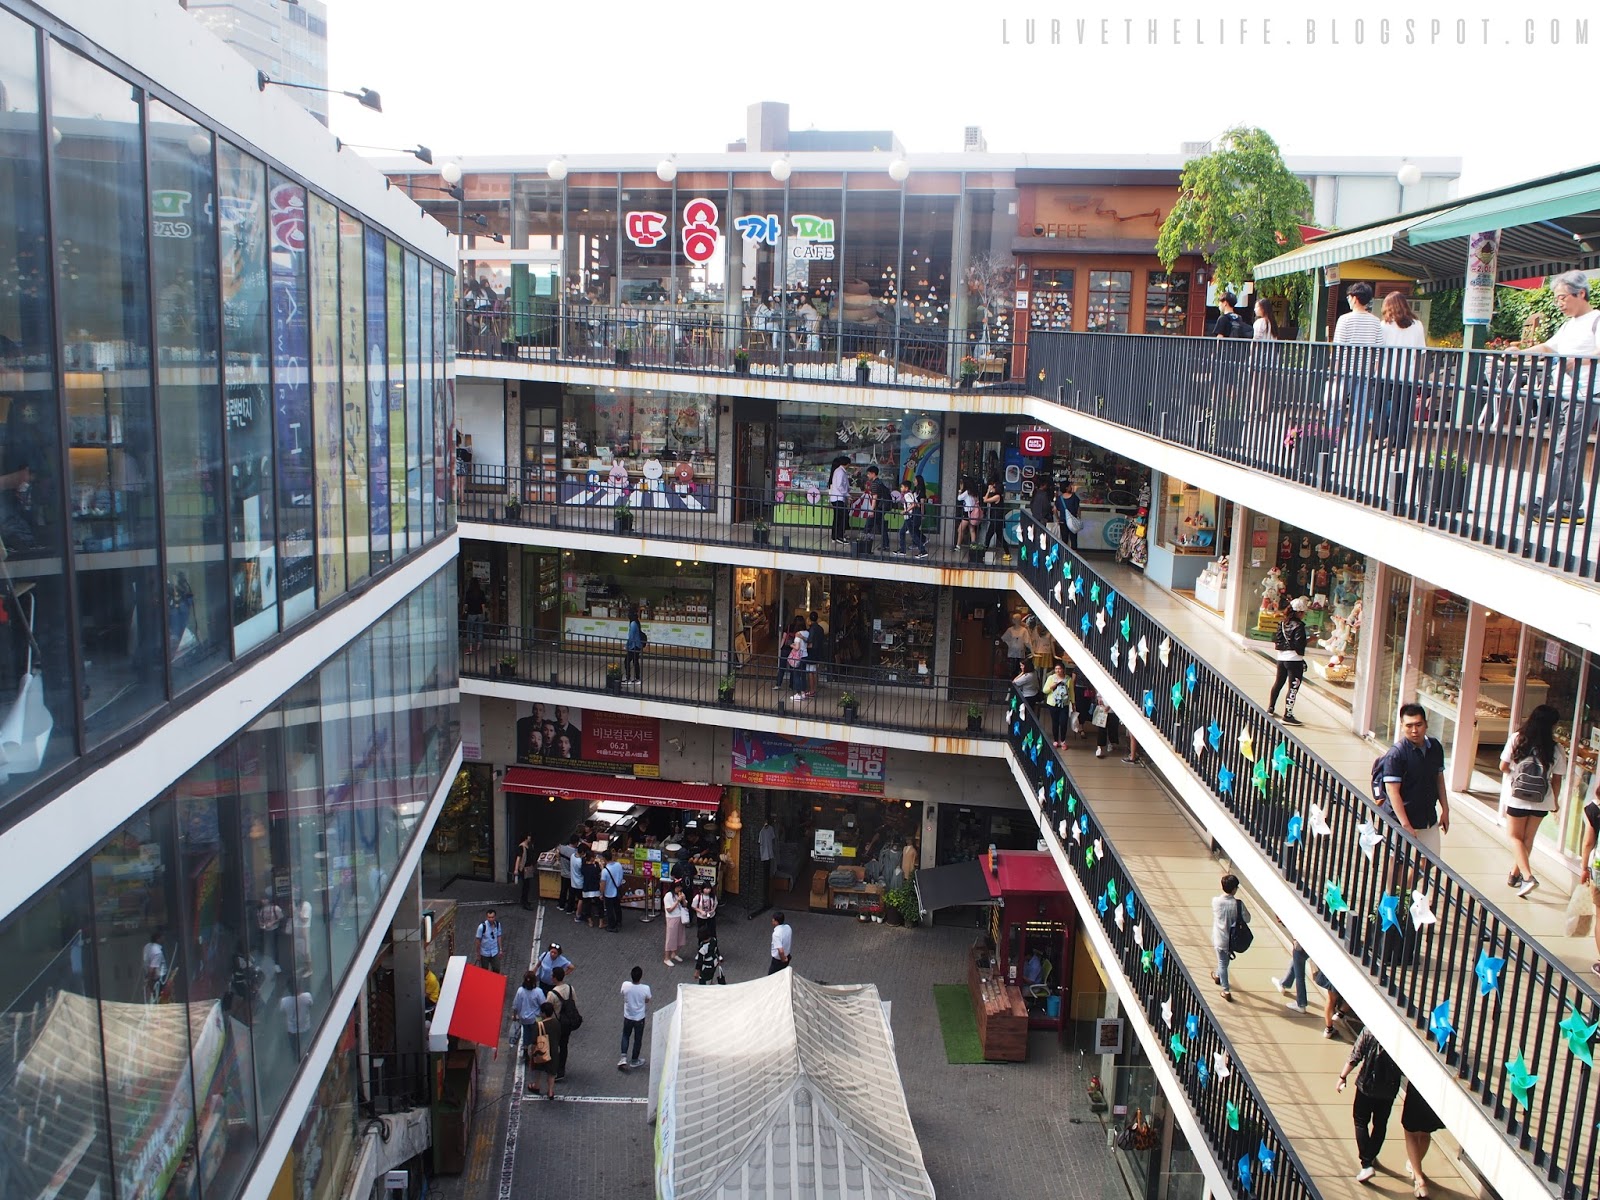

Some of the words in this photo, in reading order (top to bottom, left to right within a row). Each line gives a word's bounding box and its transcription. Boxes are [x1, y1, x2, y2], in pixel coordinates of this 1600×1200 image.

[792, 245, 834, 260] CAFE
[593, 728, 654, 742] 비보컬콘서트
[609, 742, 629, 750] 06.21
[846, 759, 883, 780] 민요
